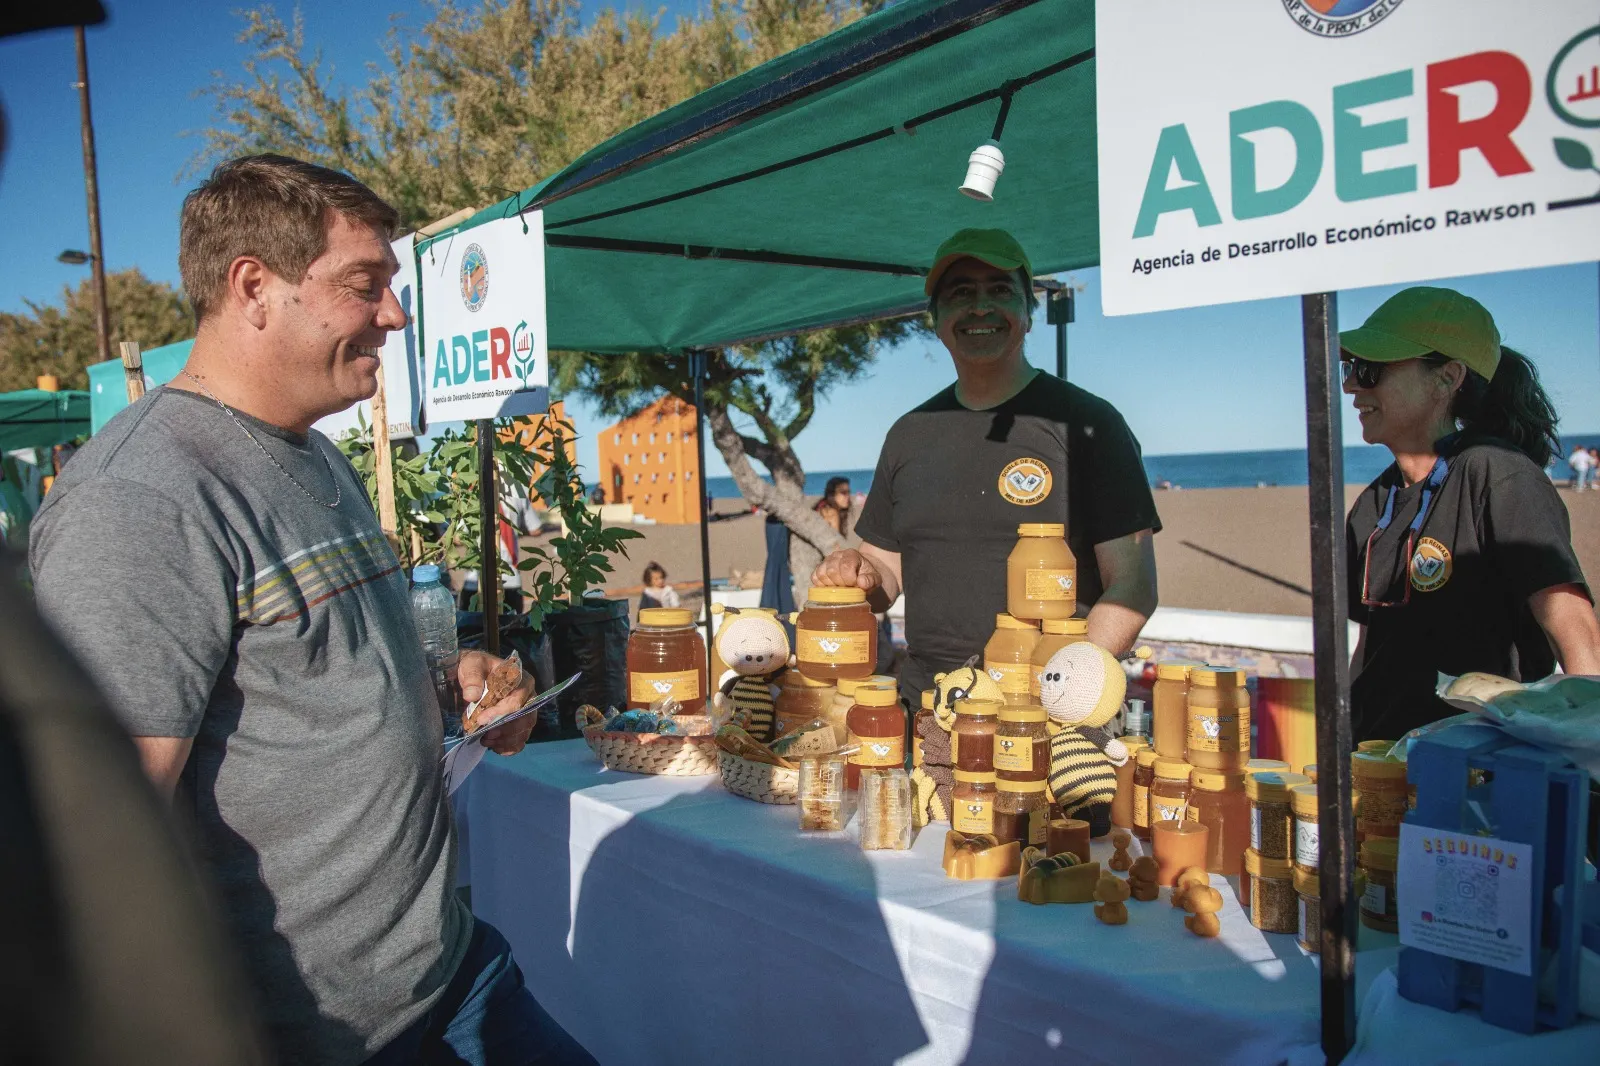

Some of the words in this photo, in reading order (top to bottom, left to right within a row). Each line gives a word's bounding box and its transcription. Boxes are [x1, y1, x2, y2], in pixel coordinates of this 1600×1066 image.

[1299, 14, 1311, 26] de
[1314, 20, 1323, 32] la
[1369, 3, 1388, 22] del
[1132, 50, 1534, 239] ADER
[1132, 249, 1195, 274] Agencia
[1201, 245, 1221, 263] de
[1228, 231, 1318, 260] Desarrollo
[1325, 214, 1437, 246] Económico
[1446, 200, 1536, 228] Rawson
[433, 327, 513, 389] ADER
[433, 396, 446, 405] Agencia
[453, 392, 471, 402] Desarrollo
[495, 389, 513, 397] Rawson
[1002, 461, 1019, 477] DOBLE
[1030, 459, 1050, 475] REINAS
[1005, 492, 1015, 502] MIEL
[1429, 539, 1449, 558] REINAS
